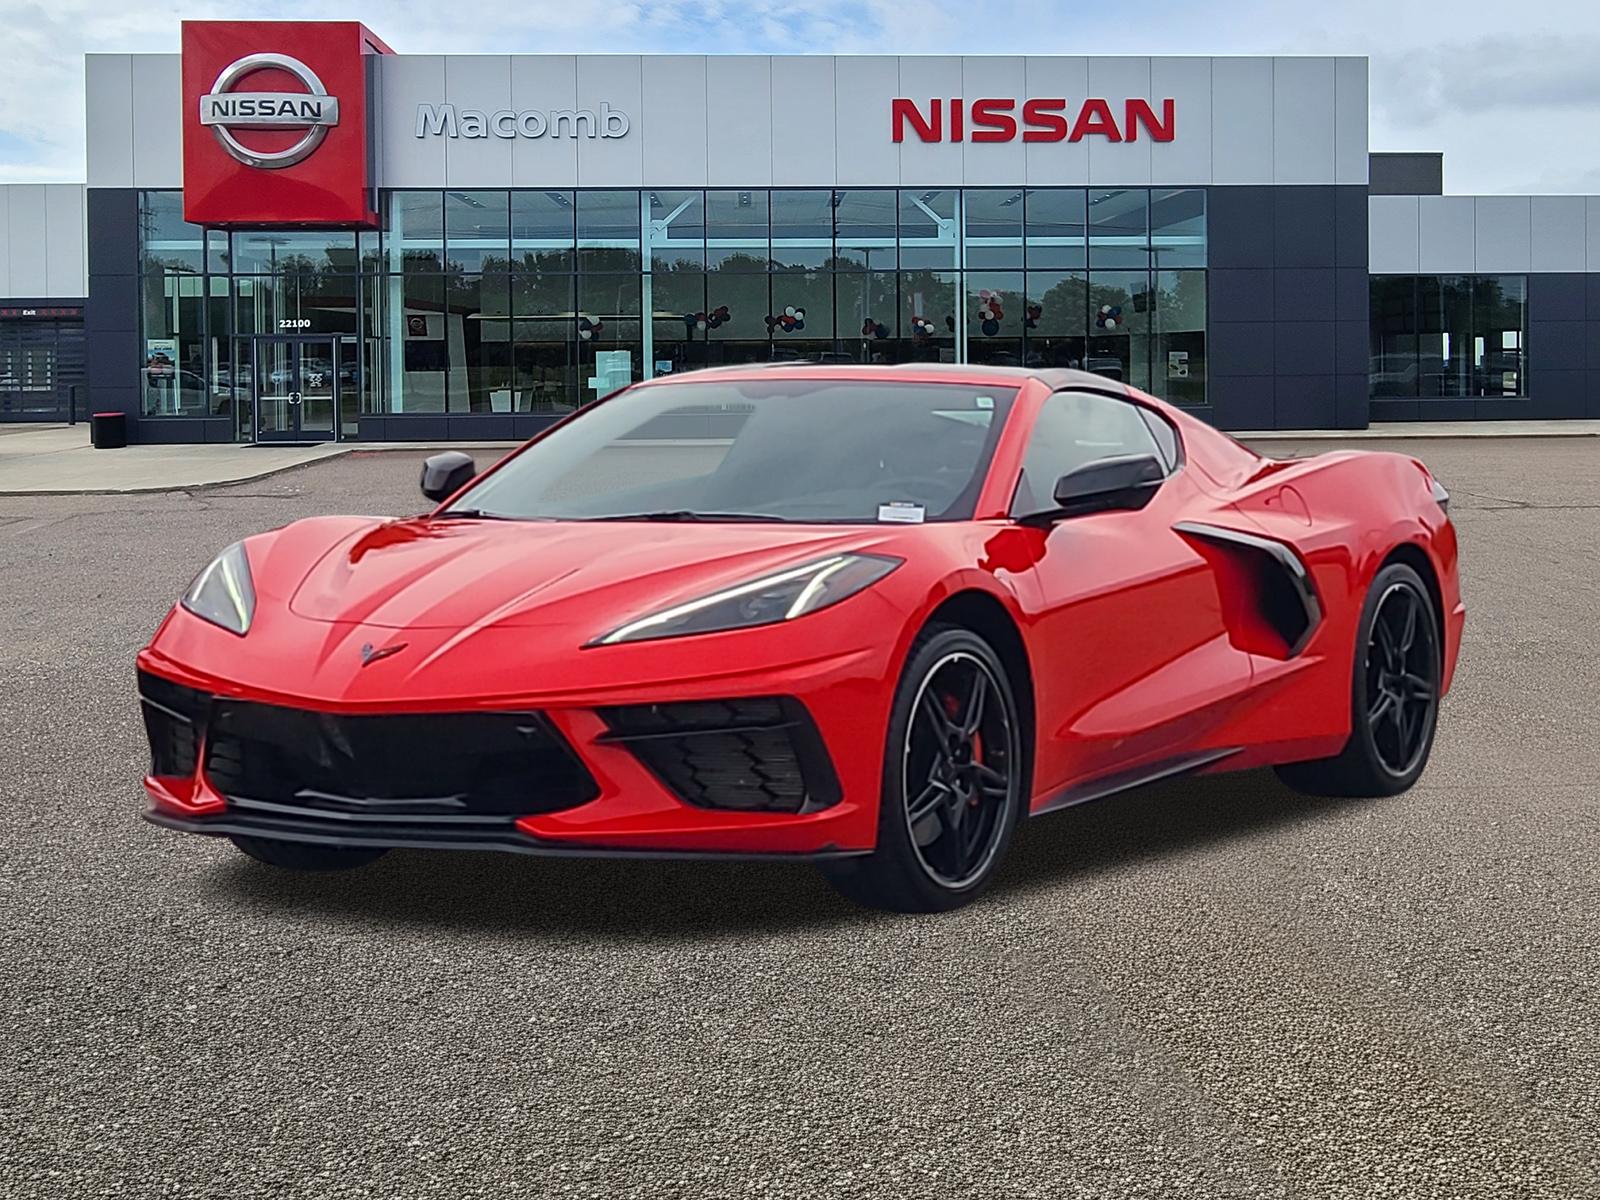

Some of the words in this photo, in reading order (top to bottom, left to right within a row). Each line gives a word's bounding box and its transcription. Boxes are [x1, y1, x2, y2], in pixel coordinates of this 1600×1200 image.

[212, 100, 321, 117] NISSAN
[415, 101, 630, 138] Macomb
[892, 98, 1175, 142] NISSAN
[279, 319, 311, 328] 22100
